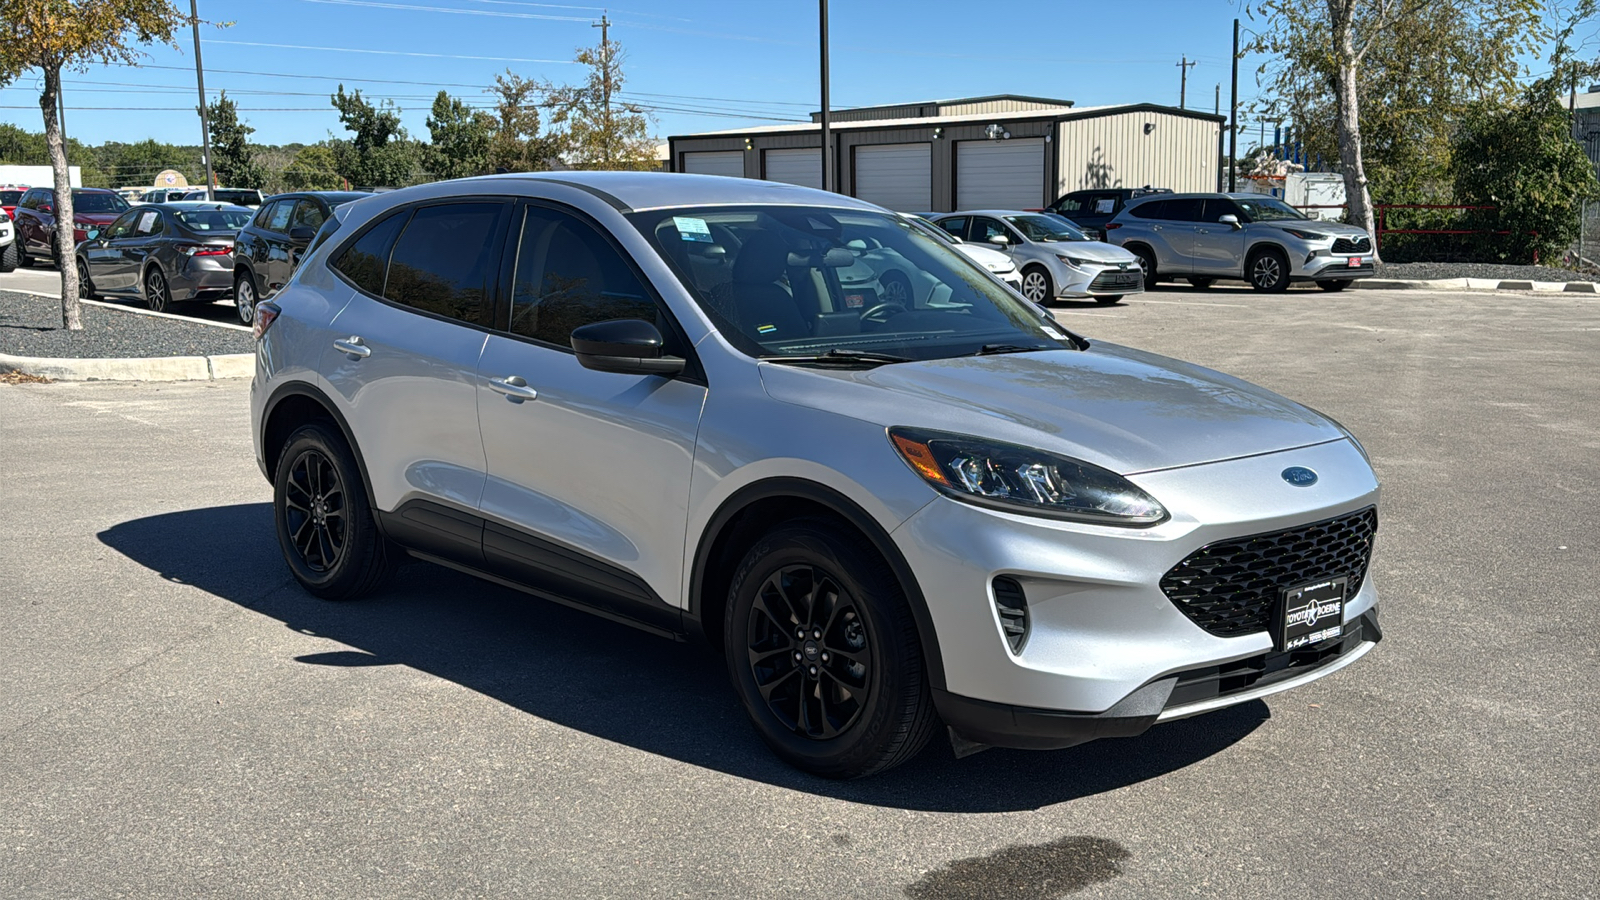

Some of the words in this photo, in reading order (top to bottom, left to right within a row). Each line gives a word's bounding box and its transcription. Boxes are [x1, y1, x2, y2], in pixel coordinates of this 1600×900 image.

[1291, 470, 1312, 482] Ford
[1287, 610, 1308, 624] TOYOTA
[1318, 602, 1341, 615] BOERNE
